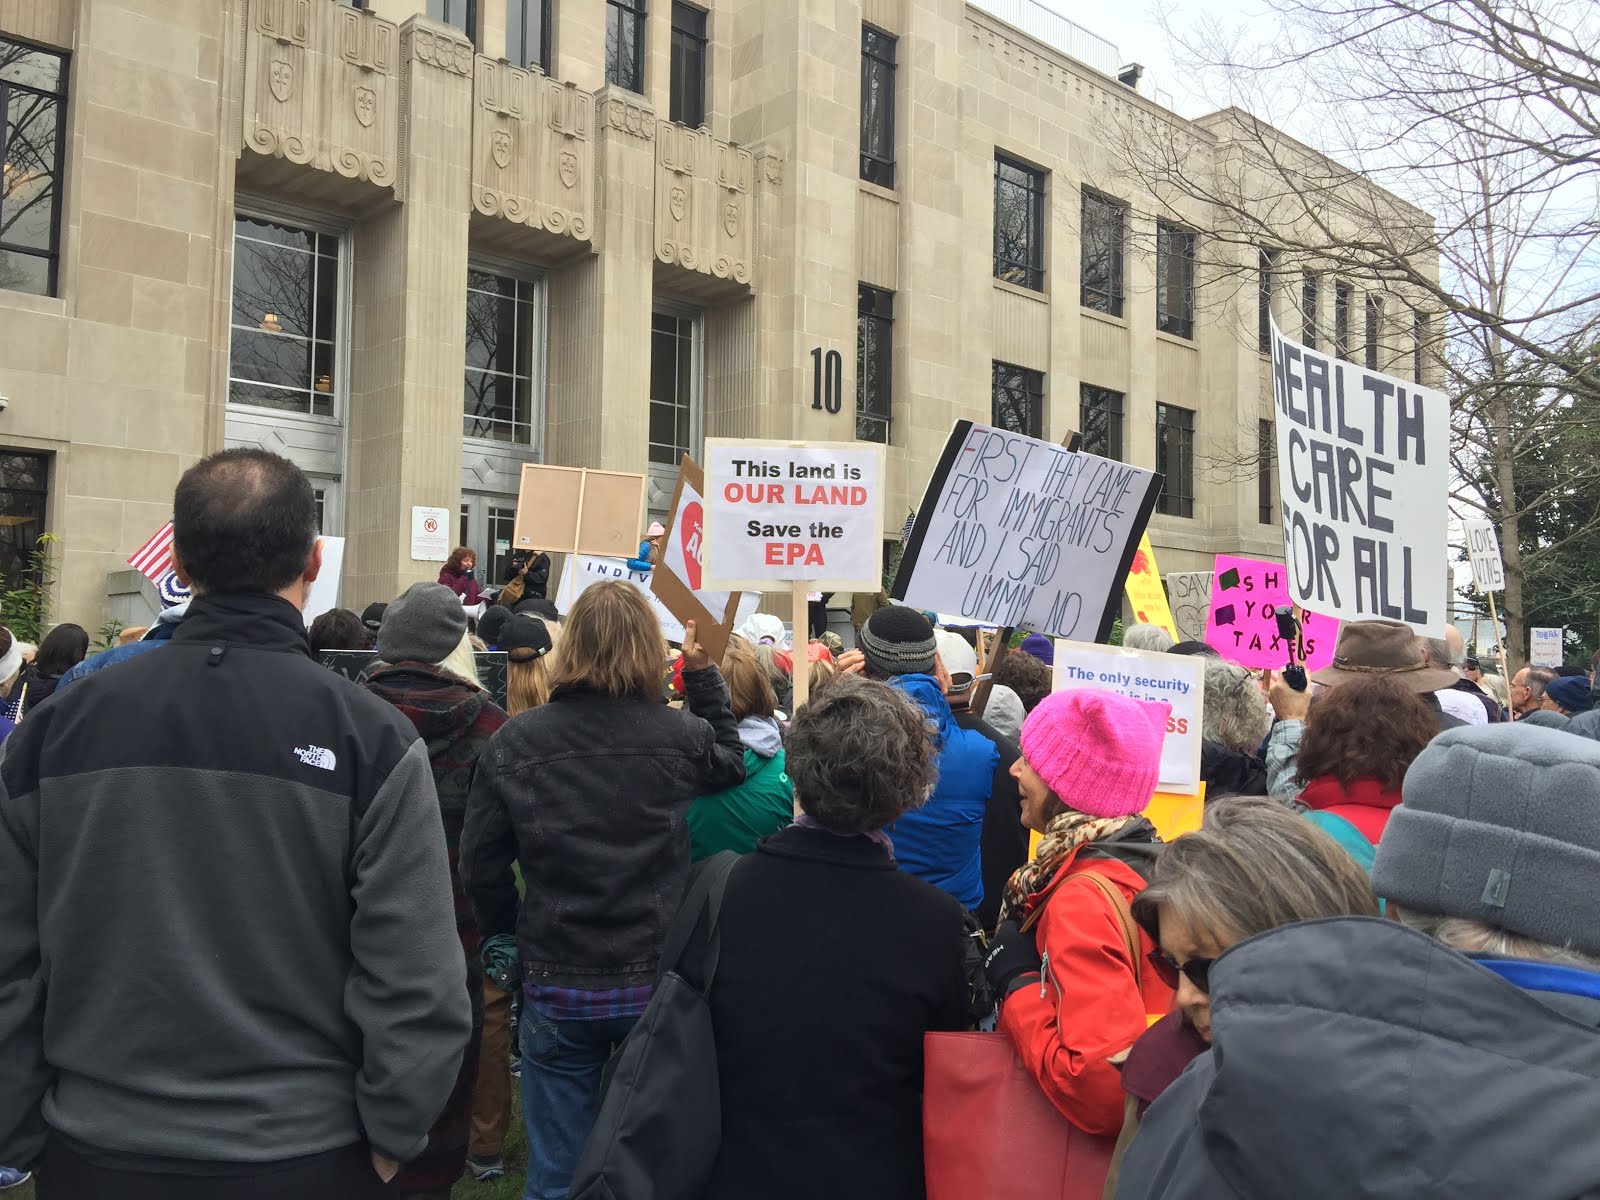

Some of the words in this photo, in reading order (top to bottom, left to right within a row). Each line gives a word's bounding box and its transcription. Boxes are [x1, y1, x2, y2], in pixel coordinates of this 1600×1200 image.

[810, 347, 842, 414] 10
[1271, 325, 1426, 466] HEALTH
[732, 460, 781, 478] This
[789, 462, 835, 479] land
[843, 464, 861, 480] is
[954, 428, 1039, 486] FIRST
[1040, 448, 1090, 499] THEY
[1082, 461, 1142, 514] CAME
[1289, 427, 1395, 534] CARE
[724, 482, 785, 504] OUR
[794, 485, 867, 506] LAND
[942, 473, 989, 521] FOR
[998, 487, 1121, 554] IMMIGRANTS
[747, 520, 801, 538] Save
[808, 521, 844, 539] the
[1469, 527, 1496, 553] LOVE
[765, 542, 825, 566] EPA
[933, 520, 987, 569] AND
[989, 530, 1009, 573] I
[1007, 537, 1061, 586] SAID
[587, 562, 649, 583] INDIV
[1243, 571, 1278, 592] SH
[1353, 535, 1428, 626] ALL
[1177, 573, 1214, 598] SAV
[1044, 589, 1082, 638] NO
[1245, 600, 1312, 624] YOR
[1067, 666, 1094, 680] The
[1099, 672, 1130, 687] only
[1135, 678, 1190, 694] security
[293, 747, 322, 761] NORTH
[308, 744, 325, 754] THE
[300, 757, 321, 767] FACE
[984, 944, 1004, 968] HEAD
